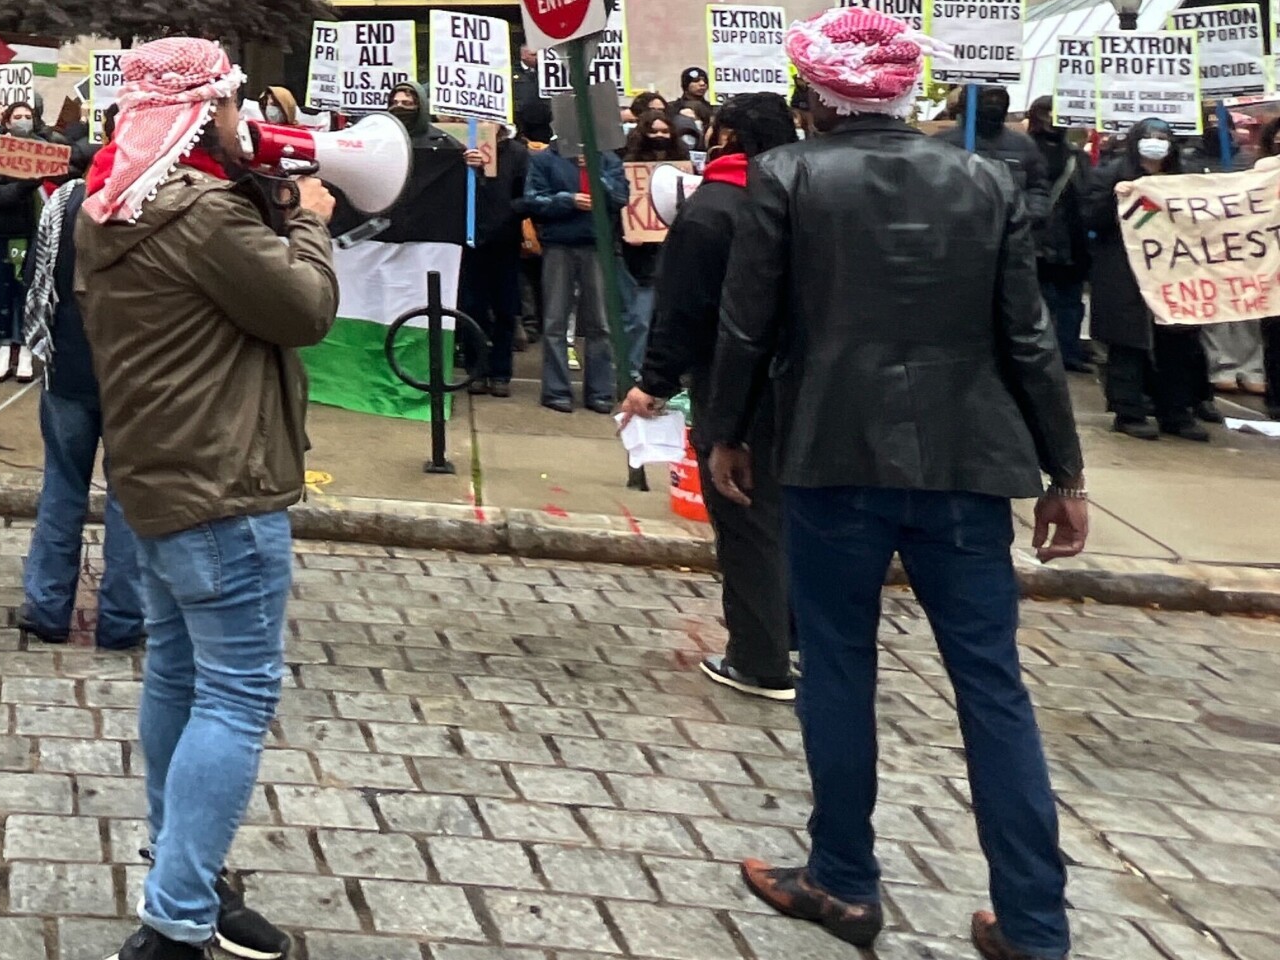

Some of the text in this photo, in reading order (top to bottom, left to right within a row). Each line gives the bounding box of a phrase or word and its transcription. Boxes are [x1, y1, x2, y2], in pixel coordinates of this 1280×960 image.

[711, 10, 783, 29] TEXTRON
[933, 3, 1020, 20] SUPPORTS
[1174, 8, 1258, 30] TEXTRON
[356, 23, 395, 45] END
[451, 15, 491, 41] END
[712, 29, 783, 45] SUPPORTS
[1198, 25, 1259, 43] PPORTS
[359, 45, 393, 66] ALL
[455, 40, 490, 65] ALL
[954, 44, 1020, 61] NOCIDE.
[1101, 36, 1193, 55] TEXTRON
[544, 62, 622, 87] RIHT!
[714, 67, 788, 84] GENOCIDE.
[1101, 57, 1191, 75] PROFITS
[1200, 62, 1263, 79] NOCIDE.
[344, 71, 376, 90] U.S.
[437, 65, 504, 94] U.S. AID
[342, 91, 389, 105] TO ISRA
[436, 87, 505, 112] TO ISRAEL!
[0, 137, 69, 159] TEXTRON
[1166, 187, 1272, 224] FREE
[1142, 224, 1280, 271] PALEST
[1162, 274, 1272, 305] END THE
[1169, 295, 1269, 319] END THE
